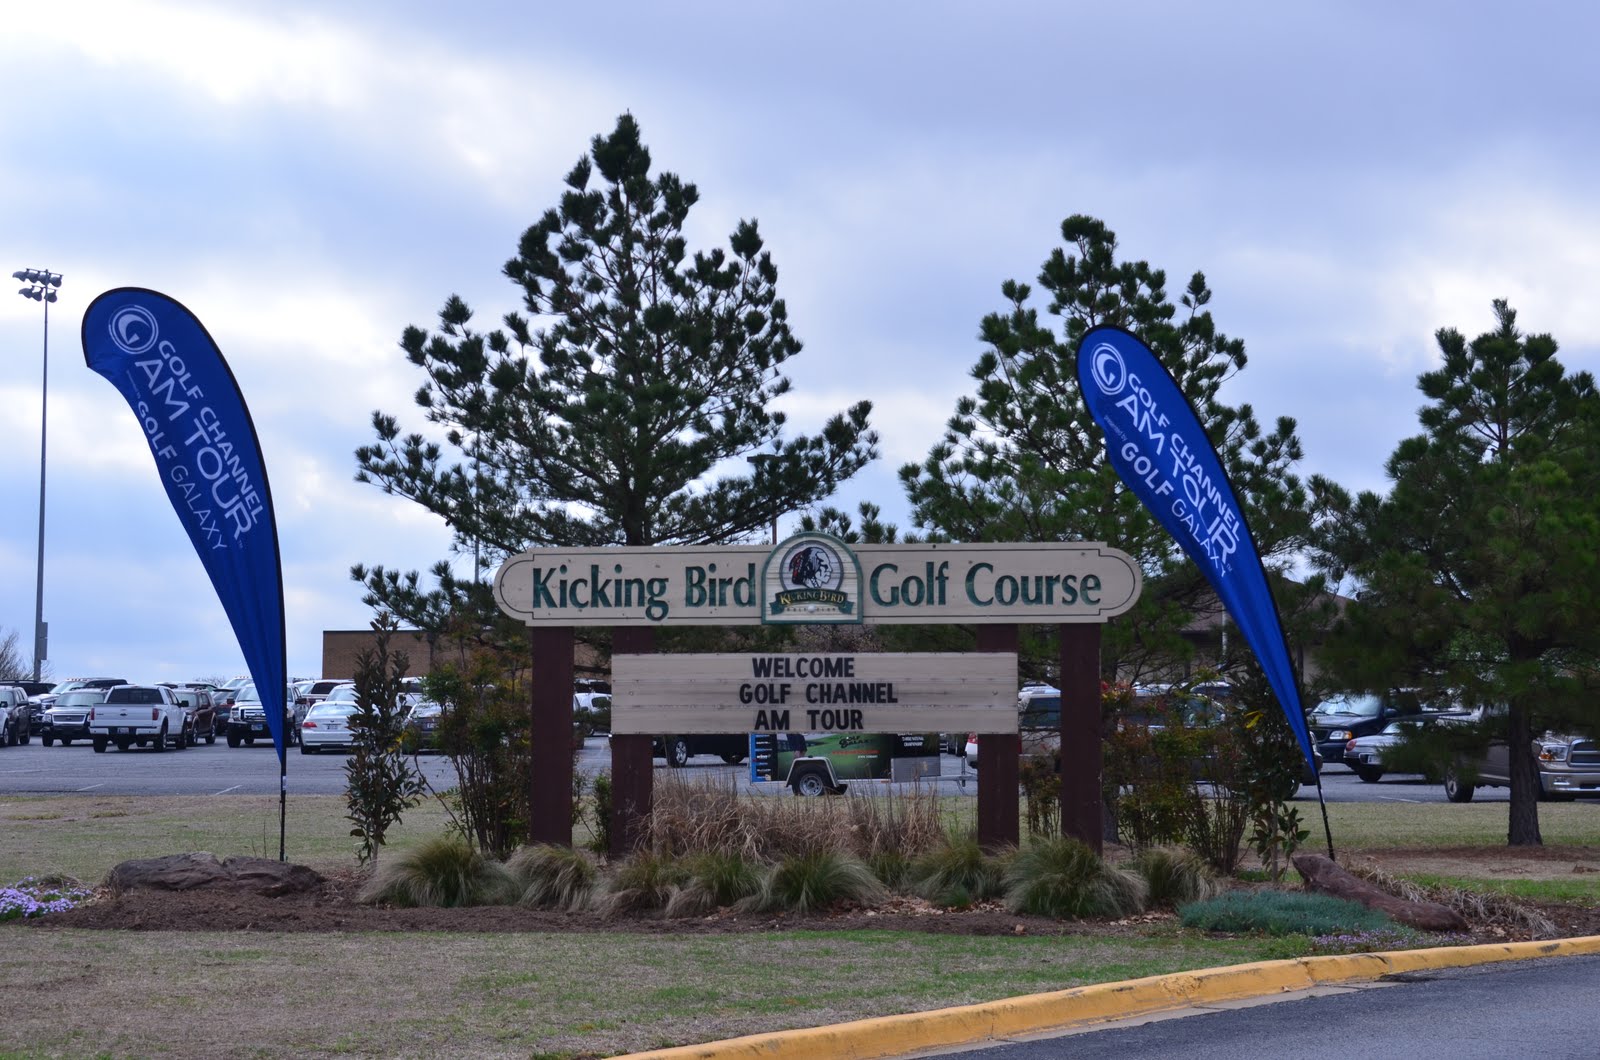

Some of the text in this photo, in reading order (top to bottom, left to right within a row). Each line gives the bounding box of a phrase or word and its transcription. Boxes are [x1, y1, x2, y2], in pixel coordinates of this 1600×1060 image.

[134, 358, 253, 541] AM TOUR
[138, 400, 228, 550] GOLF GALAXY
[158, 340, 264, 525] GOLF CHANNEL
[1115, 394, 1237, 565] AM TOUR
[1128, 372, 1240, 542] GOLF CHANNEL
[1120, 442, 1226, 578] GOLF GALAXY
[532, 561, 1101, 621] Kicking Bird Golf Course
[739, 683, 898, 704] GOLF CHANNEL
[752, 657, 855, 678] WELCOME
[754, 709, 864, 731] AM TOUR
